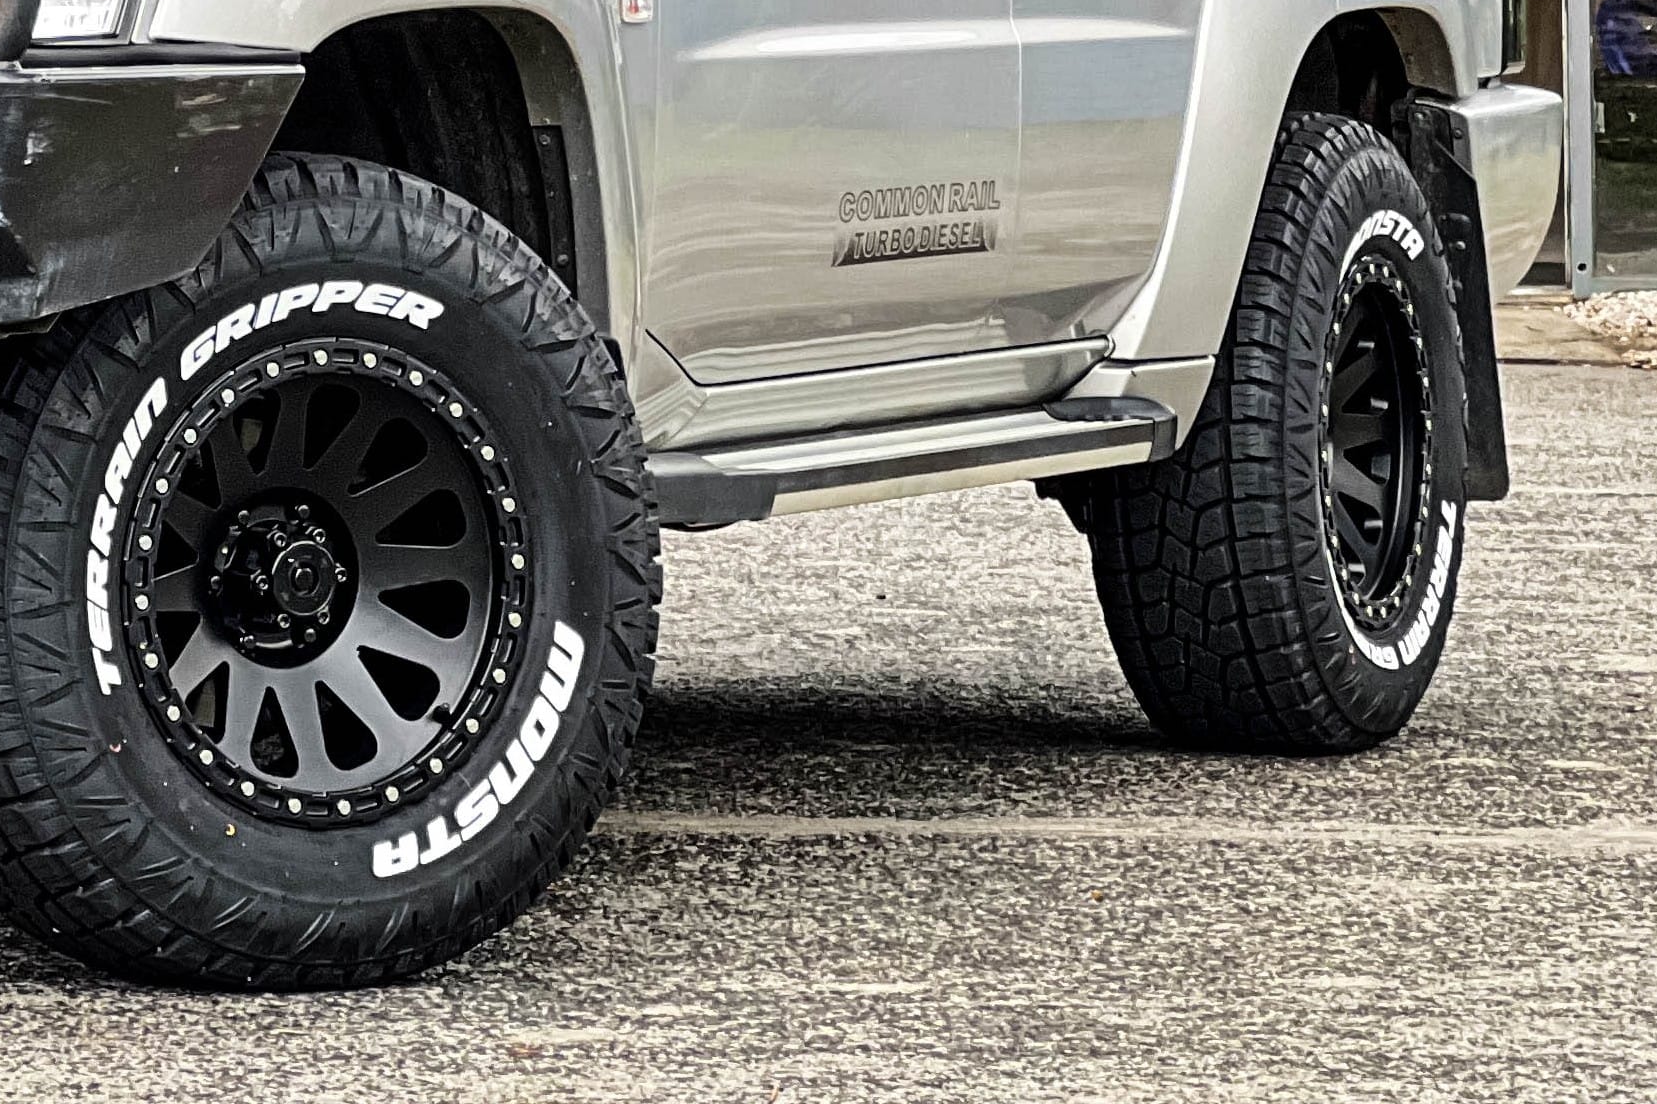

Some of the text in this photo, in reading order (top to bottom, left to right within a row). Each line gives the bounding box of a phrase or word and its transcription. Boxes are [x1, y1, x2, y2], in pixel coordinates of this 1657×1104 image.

[838, 180, 1001, 224] COMMON RAIL
[853, 221, 982, 260] TURBO DIESEL
[86, 279, 446, 696] TERRAIN GRIPPER
[371, 620, 587, 879] MONSTA
